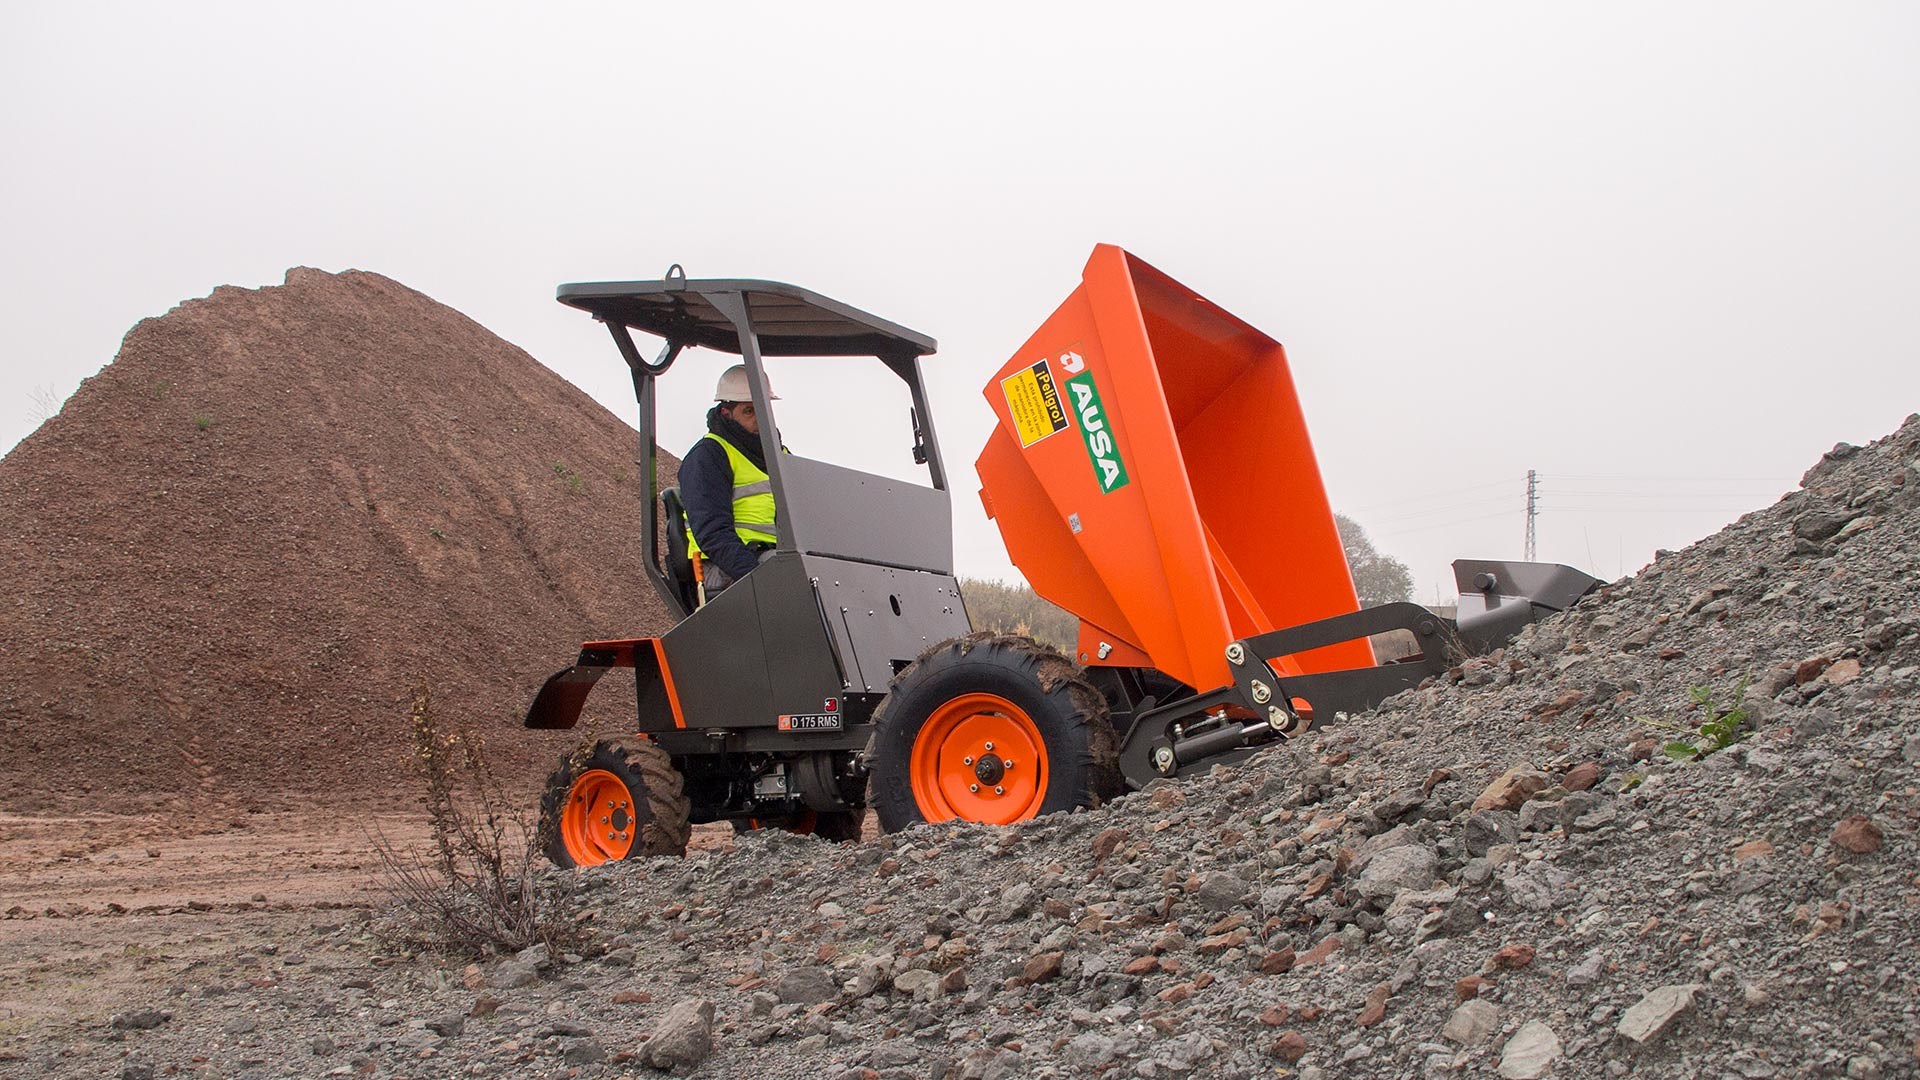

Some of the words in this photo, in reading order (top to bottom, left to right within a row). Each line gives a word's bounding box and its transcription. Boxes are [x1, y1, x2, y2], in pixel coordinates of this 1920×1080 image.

[1036, 371, 1064, 423] ¡Peligro!
[1070, 382, 1120, 489] AUSA
[791, 717, 798, 728] D
[800, 716, 816, 728] 175
[817, 715, 838, 727] RMS
